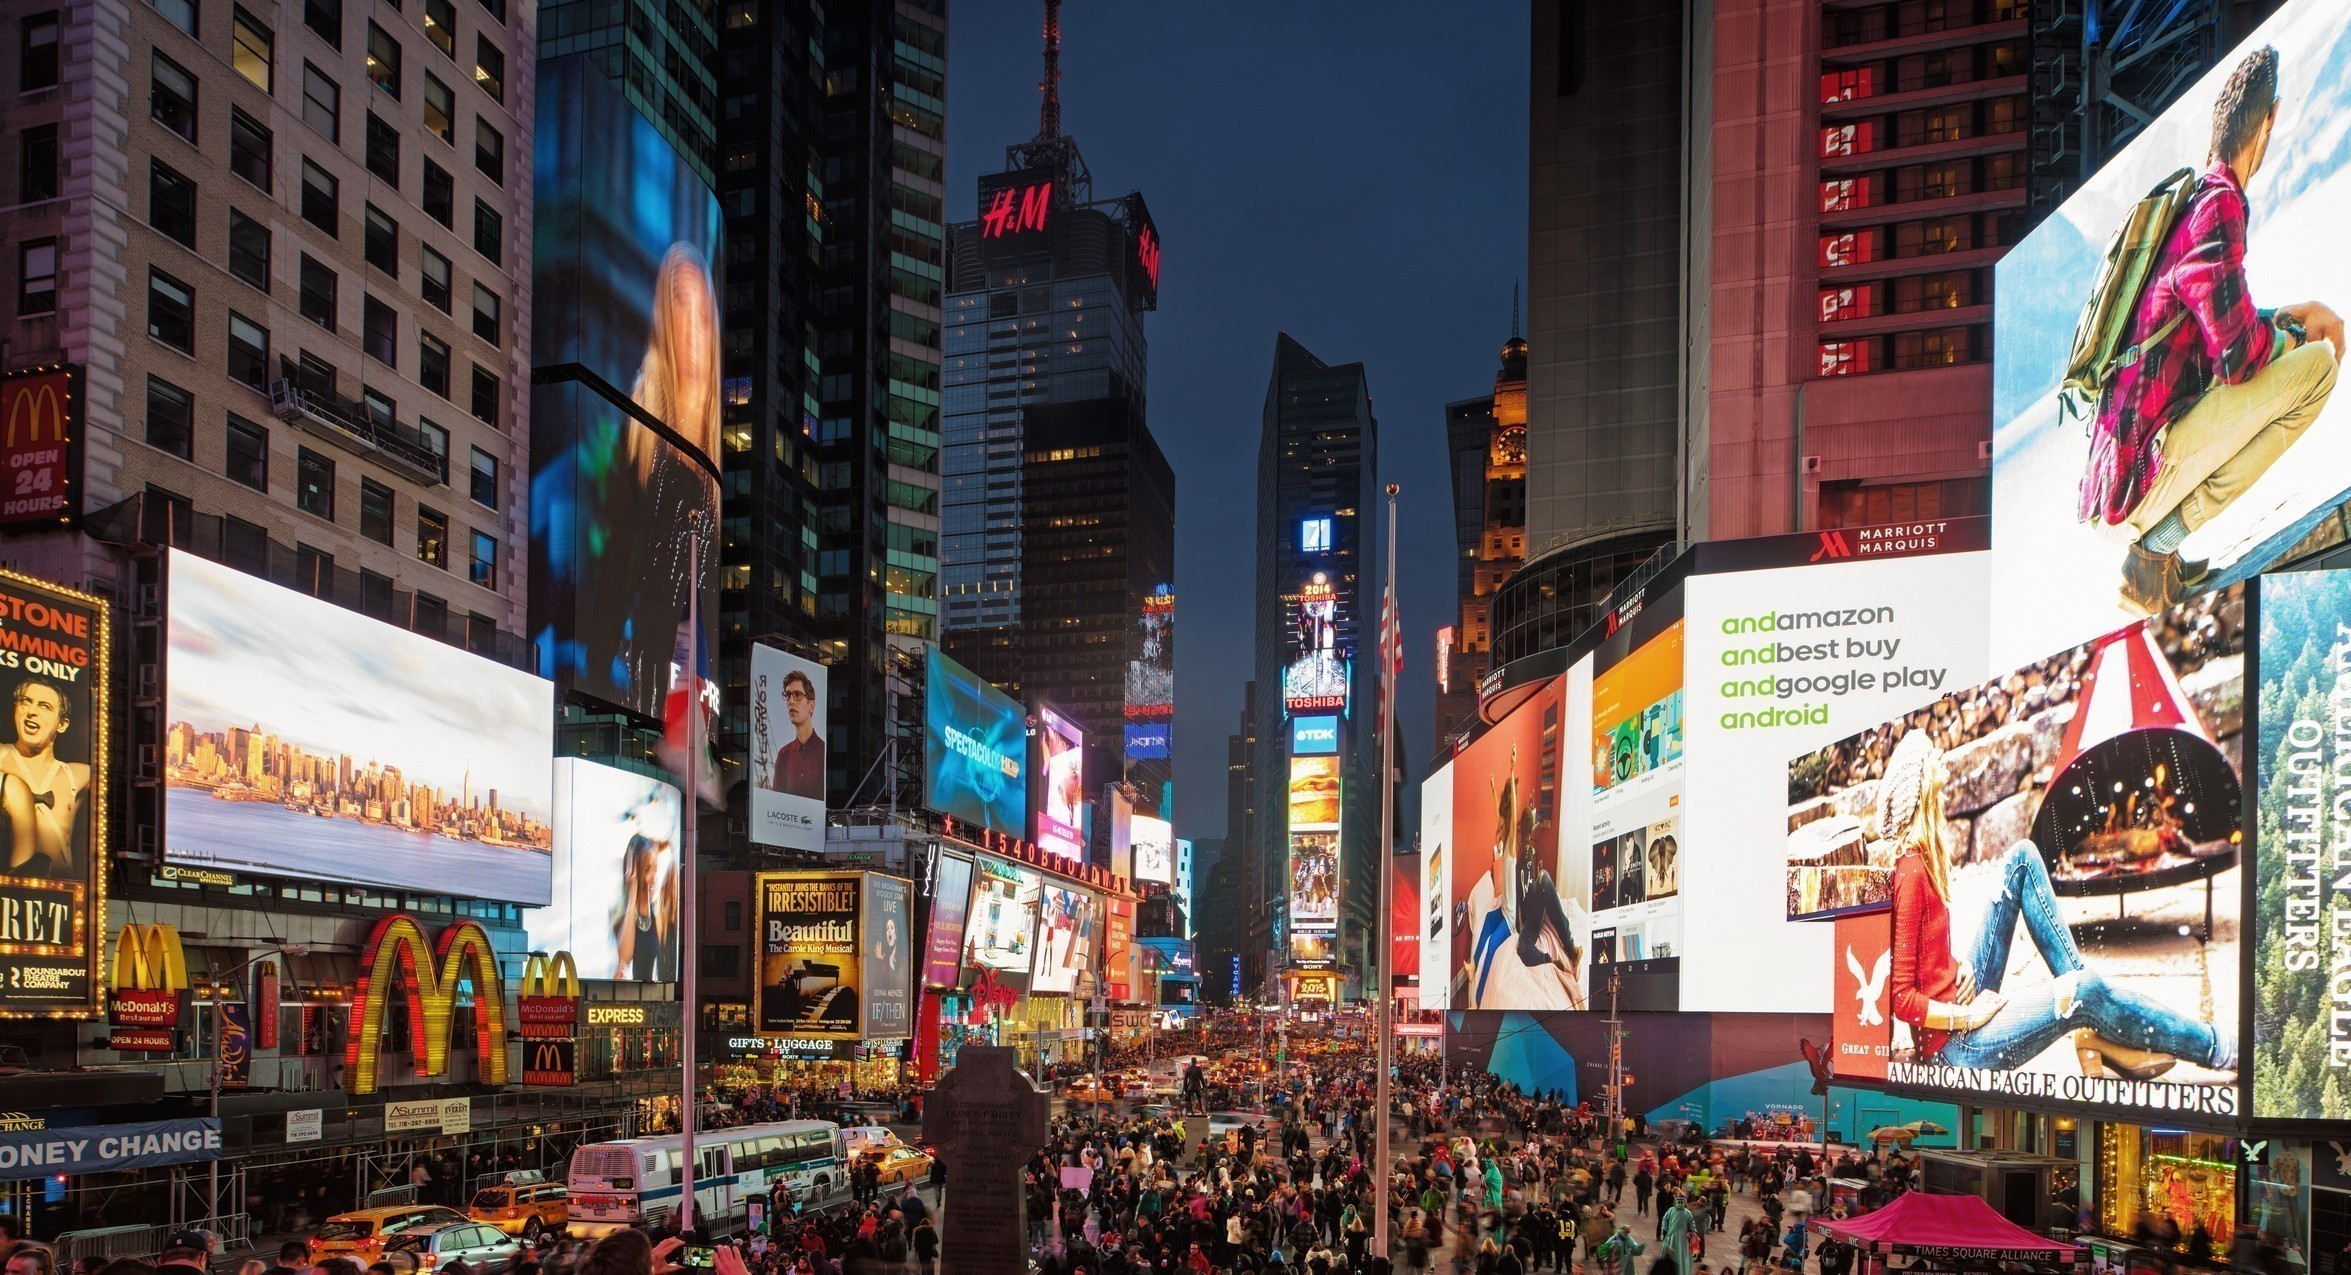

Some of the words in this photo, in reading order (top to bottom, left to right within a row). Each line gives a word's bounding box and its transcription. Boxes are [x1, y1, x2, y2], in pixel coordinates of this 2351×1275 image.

[983, 182, 1051, 239] H&M
[1139, 223, 1160, 291] H&M
[10, 449, 58, 468] OPEN
[15, 467, 52, 495] 24
[4, 494, 64, 516] HOURS
[1860, 523, 1947, 539] MARRIOTT
[1860, 537, 1937, 554] MARQUIS
[1305, 584, 1331, 595] 2014
[1299, 593, 1337, 602] TOSHIBA
[1619, 588, 1645, 616] MARRIOTT
[1618, 602, 1643, 627] MARQUIS
[1721, 604, 1895, 635] andamazon
[1721, 639, 1840, 667] andbest
[1846, 636, 1902, 661] buy
[25, 656, 80, 682] ONLY
[1720, 668, 1876, 700] andgoogle
[1882, 666, 1948, 693] play
[1287, 697, 1345, 709] TOSHIBA
[1720, 703, 1829, 729] android
[1306, 730, 1334, 740] TDK
[944, 725, 1001, 772] SPECTACOLOR
[767, 810, 798, 823] LACOSTE
[2284, 719, 2323, 974] OUTFITTERS
[982, 828, 1035, 862] 1540
[1041, 850, 1127, 894] BROADWAY
[795, 883, 809, 891] JOINS
[810, 883, 819, 891] THE
[820, 883, 836, 892] RANKS
[837, 883, 844, 891] OF
[845, 883, 854, 891] THE
[876, 890, 893, 898] BIGGEST
[894, 892, 904, 900] STAR
[883, 901, 897, 913] LIVE
[0, 897, 68, 945] RET
[769, 920, 853, 942] Beautiful
[769, 944, 783, 953] The
[784, 944, 807, 953] Carole
[808, 944, 825, 954] King
[825, 944, 853, 953] Musical
[23, 967, 87, 977] ROUNDABOUT
[24, 974, 61, 983] THEATRE
[23, 981, 70, 989] COMPANY
[873, 989, 887, 997] IDINA
[888, 989, 904, 997] MENZEL
[110, 1001, 175, 1013] McDonald's
[520, 1005, 575, 1013] McDonald's
[872, 1001, 905, 1022] IF/THEN
[1027, 997, 1063, 1021] FOREVER
[119, 1014, 164, 1022] Restaurant
[588, 1008, 644, 1023] EXPRESS
[111, 1036, 131, 1044] OPEN
[133, 1037, 142, 1045] 24
[143, 1036, 170, 1045] HOURS
[729, 1038, 765, 1048] GIFTS
[773, 1039, 833, 1050] LUGGAGE
[861, 1039, 878, 1048] GIFTS
[881, 1039, 904, 1047] LUGGAGE
[1842, 1043, 1870, 1055] GREAT
[1889, 1062, 1981, 1091] AMERICAN
[1990, 1071, 2057, 1098] EAGLE
[2062, 1074, 2235, 1116] OUTFITTERS
[296, 1111, 319, 1120] Summit
[400, 1105, 438, 1115] Summit
[945, 1109, 981, 1118] FRANCIS
[992, 1110, 1022, 1119] DUFFY
[0, 1139, 89, 1169] ONEY
[99, 1129, 221, 1160] CHANGE
[1818, 1226, 1833, 1238] TIMES
[1914, 1245, 1949, 1257] TIMES
[1952, 1247, 1997, 1259] SQUARE
[2000, 1249, 2052, 1261] ALLIANCE
